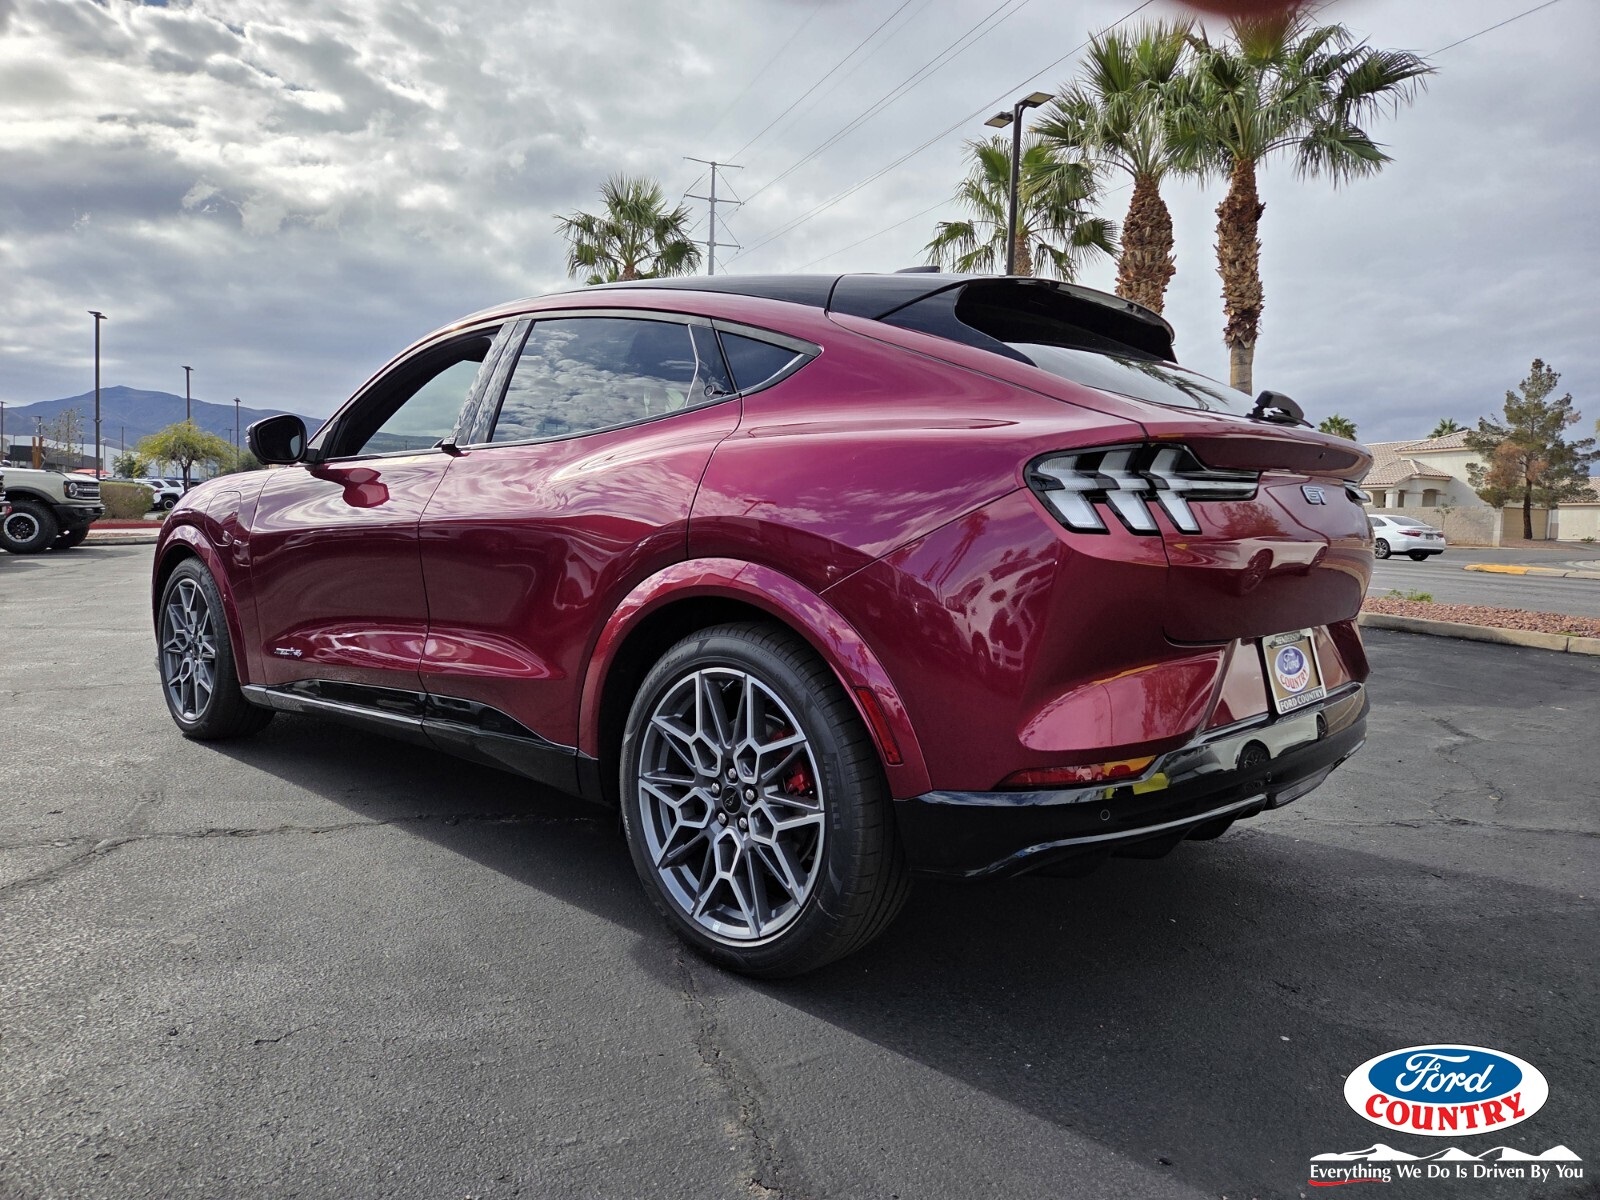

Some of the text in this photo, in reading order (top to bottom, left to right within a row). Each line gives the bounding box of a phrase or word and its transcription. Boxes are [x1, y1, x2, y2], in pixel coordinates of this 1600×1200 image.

[1283, 652, 1300, 671] Ford
[1279, 666, 1309, 689] COUNTRY
[1280, 690, 1324, 711] FORD COUNTRY
